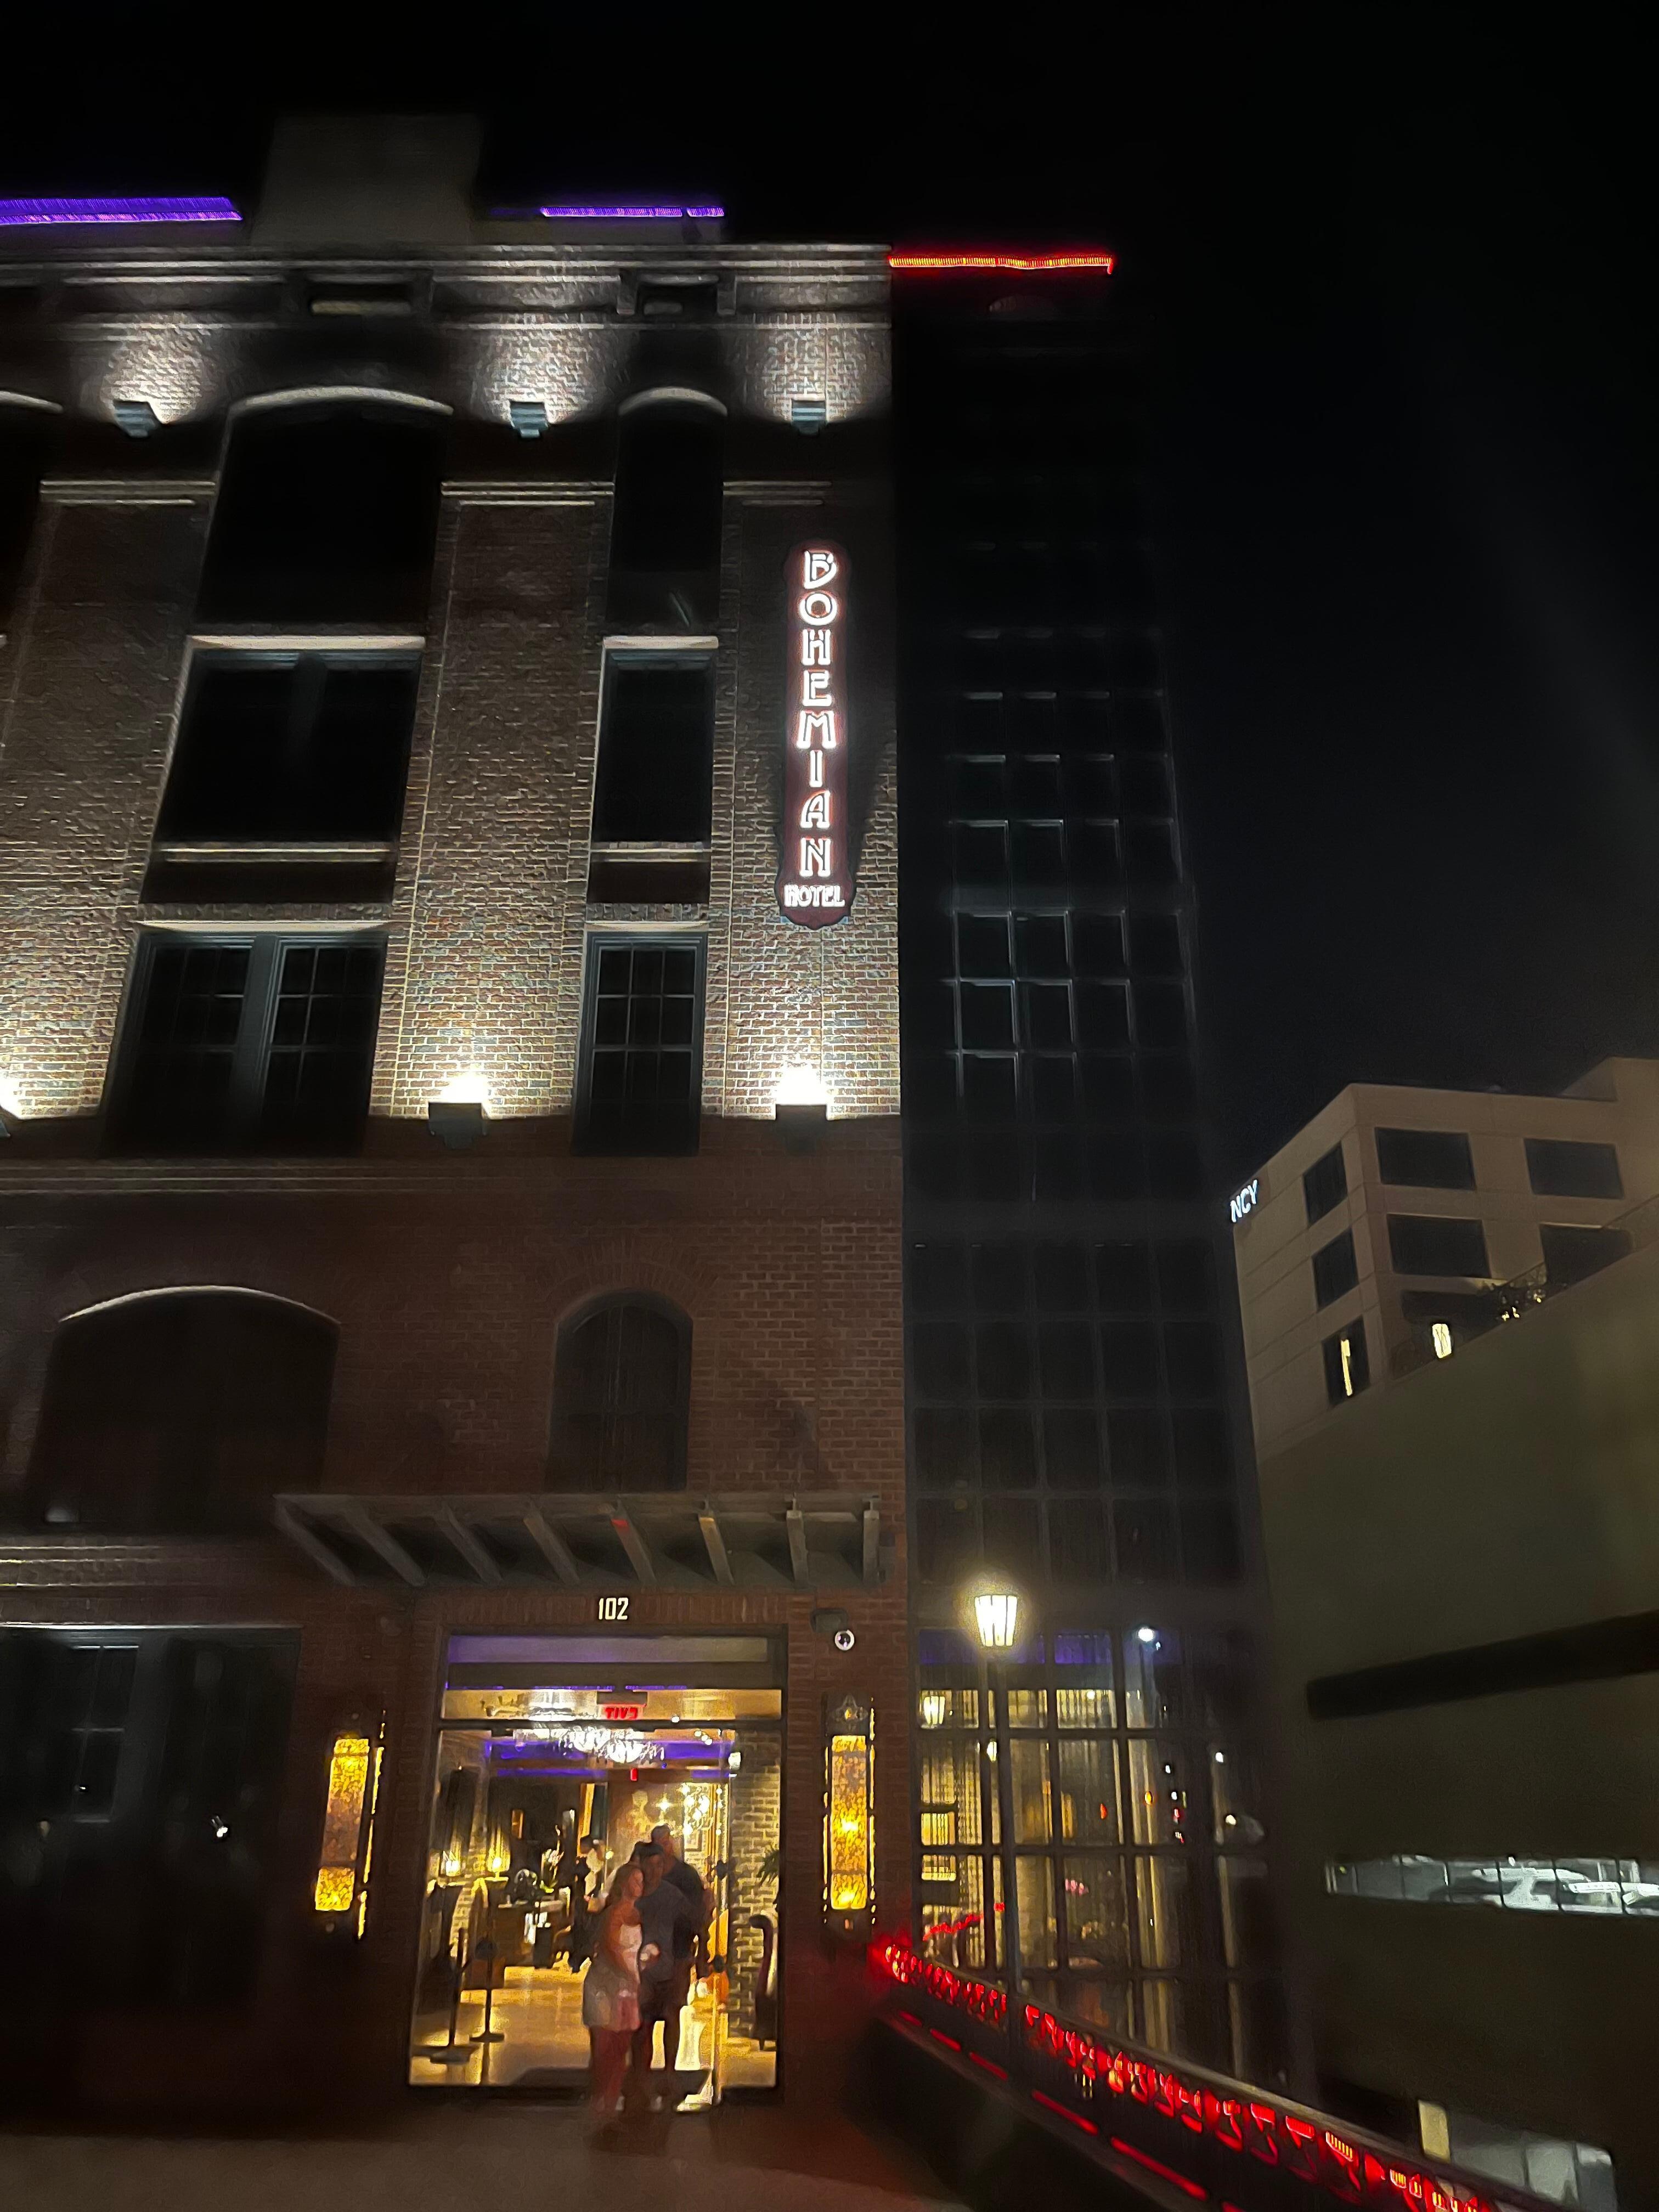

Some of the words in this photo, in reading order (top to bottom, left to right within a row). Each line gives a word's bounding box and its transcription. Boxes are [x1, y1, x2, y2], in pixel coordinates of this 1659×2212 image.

[796, 550, 838, 877] BOHEMIAN
[783, 884, 845, 907] HOTEL
[598, 1597, 629, 1620] 102
